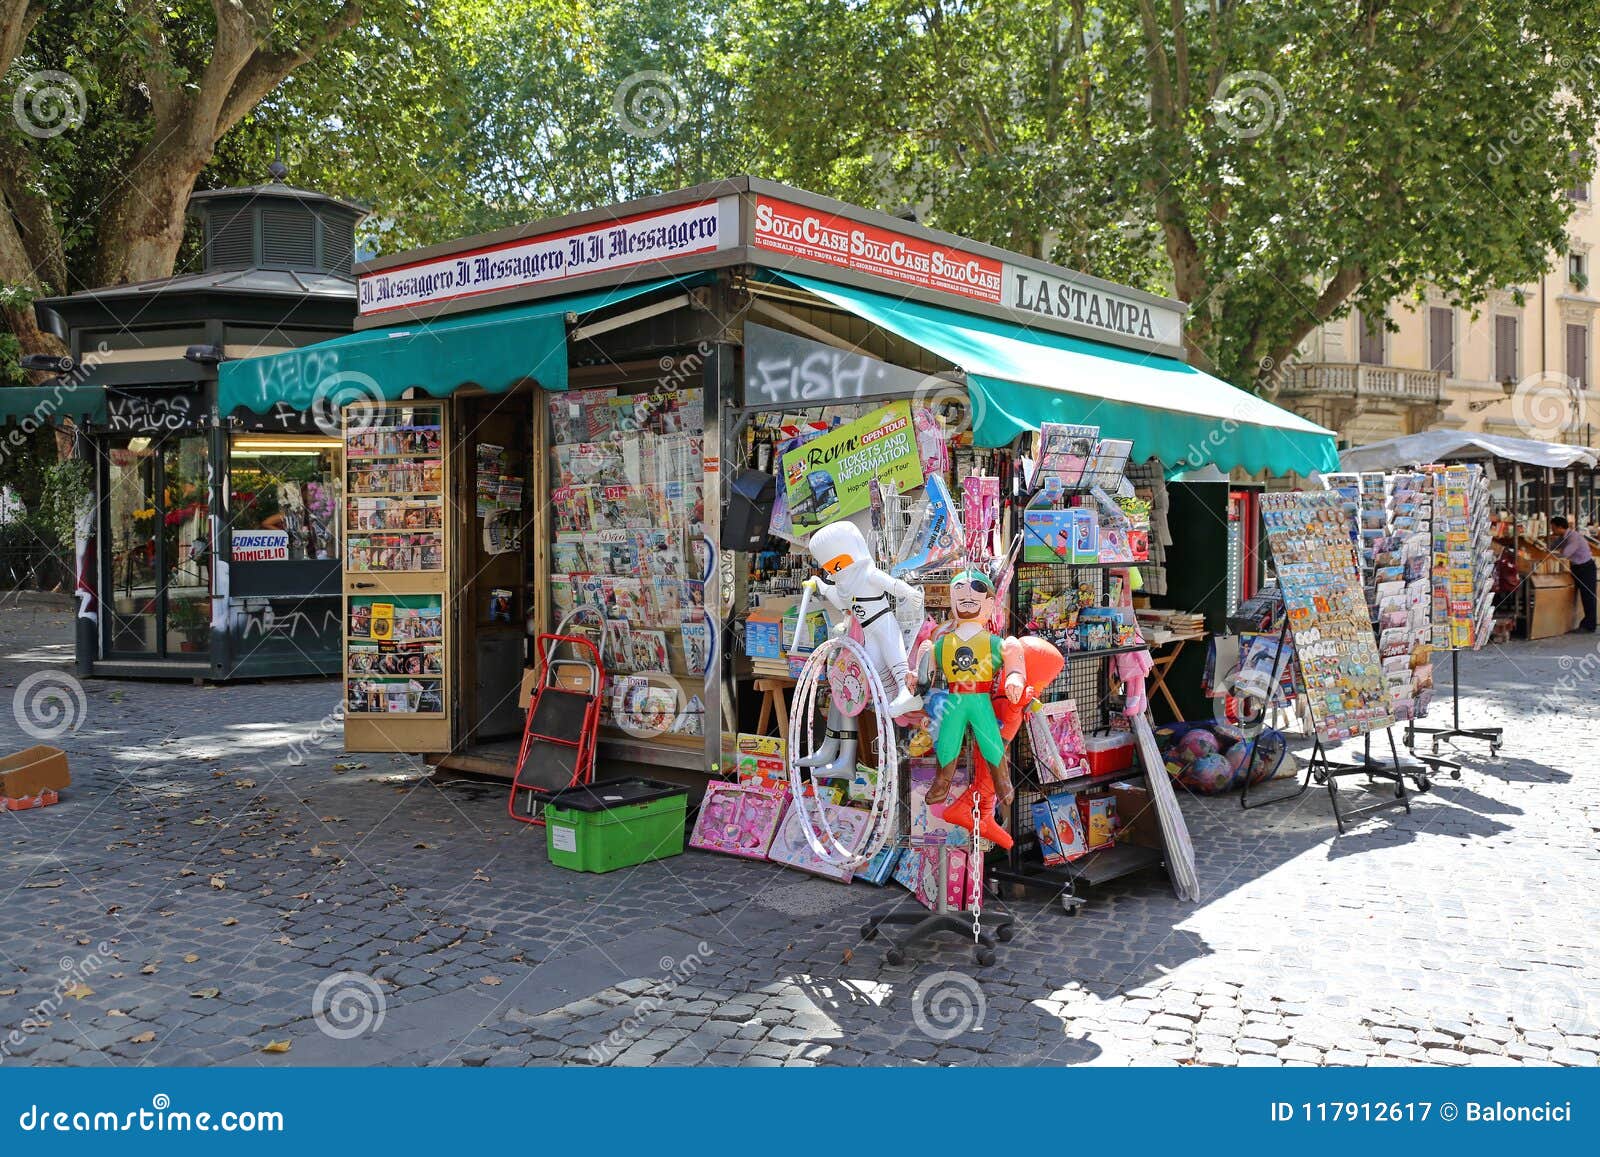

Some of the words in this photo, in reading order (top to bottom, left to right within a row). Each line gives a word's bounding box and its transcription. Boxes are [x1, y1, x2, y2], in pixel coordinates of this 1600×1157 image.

[376, 271, 454, 302] Messaggero
[473, 248, 564, 284] Messaggero
[608, 214, 717, 258] Messaggero
[756, 351, 869, 402] FISH
[861, 430, 884, 444] OPEN
[882, 419, 906, 435] TOUR
[837, 441, 910, 484] INFORMATION
[838, 443, 882, 471] TICKETS
[883, 432, 907, 449] AND
[895, 462, 910, 471] Tour
[232, 536, 288, 547] CONSEGNE
[232, 548, 285, 561] DOMICILIO
